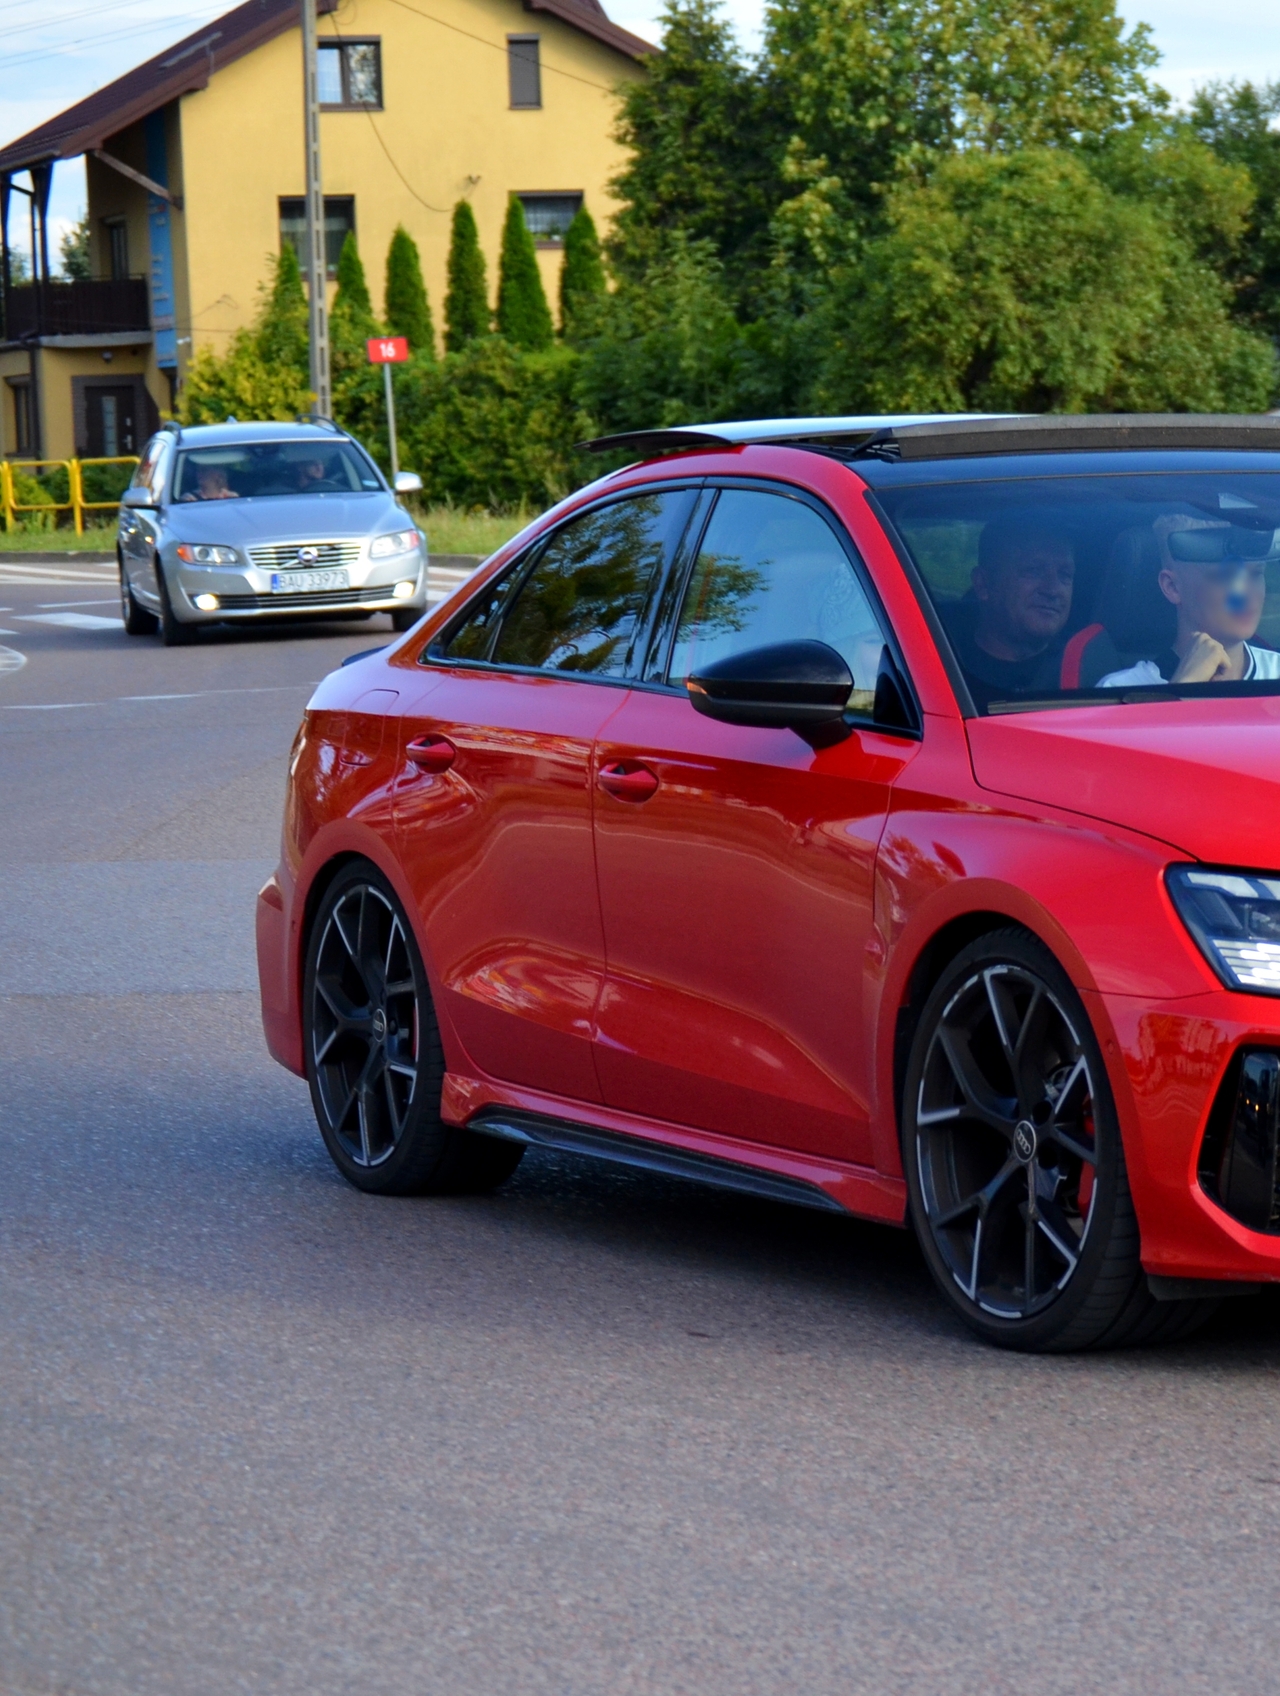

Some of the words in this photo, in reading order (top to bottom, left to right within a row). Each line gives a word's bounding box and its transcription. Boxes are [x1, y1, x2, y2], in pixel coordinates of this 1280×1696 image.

[379, 342, 396, 358] 16
[280, 574, 303, 588] BAU
[307, 571, 346, 586] 33973
